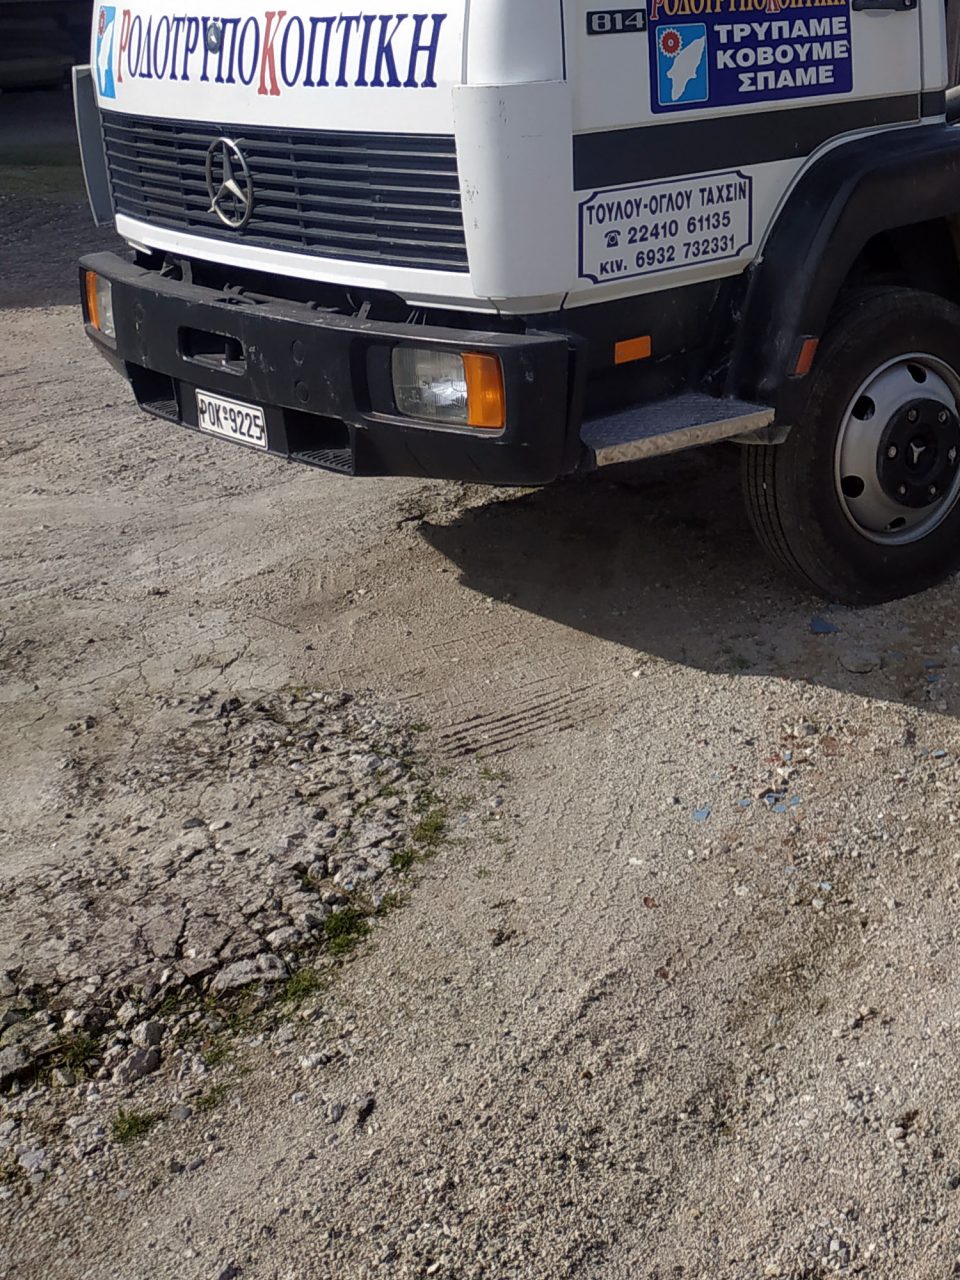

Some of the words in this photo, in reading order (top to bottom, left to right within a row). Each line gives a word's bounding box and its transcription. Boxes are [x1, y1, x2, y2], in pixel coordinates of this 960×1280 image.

[591, 12, 644, 32] 814
[713, 16, 848, 44] ΤΡΥΠΑΜΕ
[716, 40, 849, 70] ΚΟΒΟΥΜΕ
[738, 65, 835, 93] ΣΠΑΜΕ
[586, 189, 692, 225] ΤΟΥΛΟΥ-ΟΓΛΟΥ
[699, 181, 747, 206] ΤΑΧΣΙΝ
[627, 219, 679, 245] 22410
[687, 211, 731, 234] 61135
[635, 245, 676, 268] 6932
[683, 234, 735, 259] 732331
